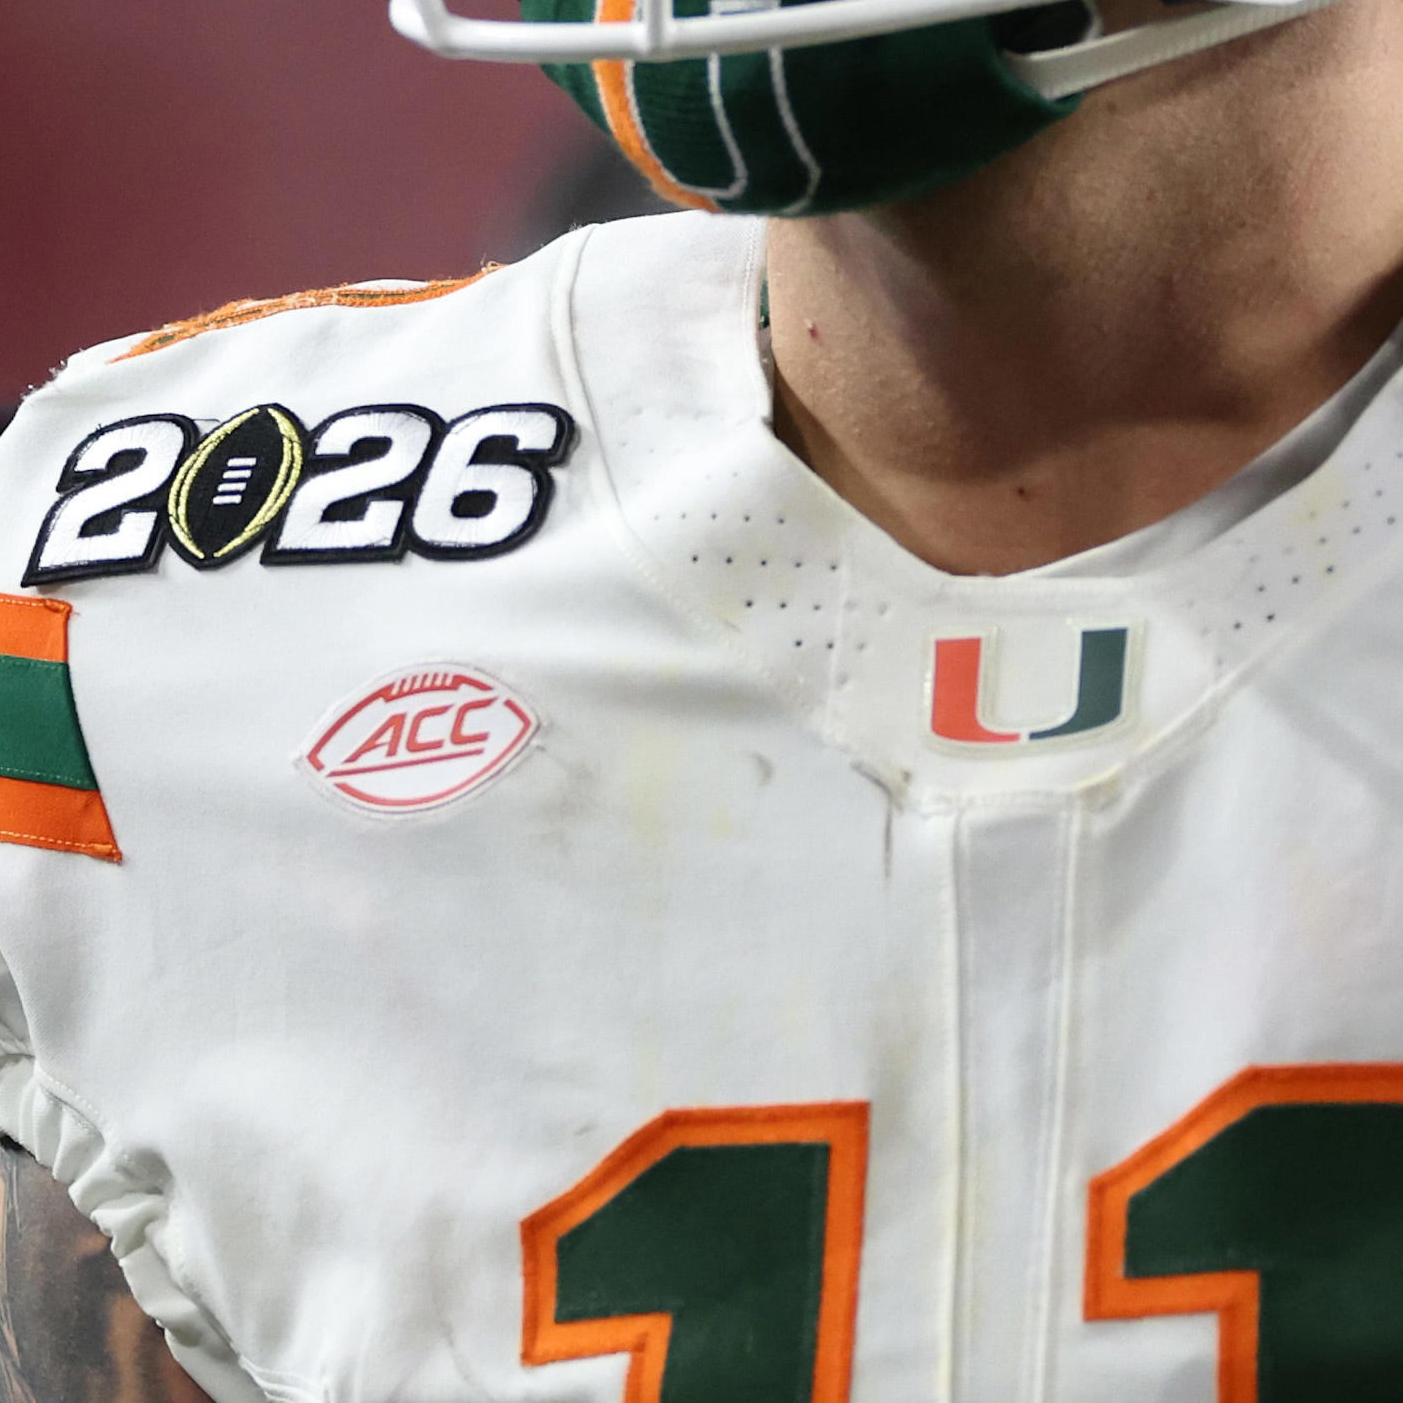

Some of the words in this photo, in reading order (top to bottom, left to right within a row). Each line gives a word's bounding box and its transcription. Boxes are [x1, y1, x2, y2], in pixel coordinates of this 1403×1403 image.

[22, 403, 580, 587] 2026
[341, 696, 500, 765] ACC
[930, 627, 1129, 744] U
